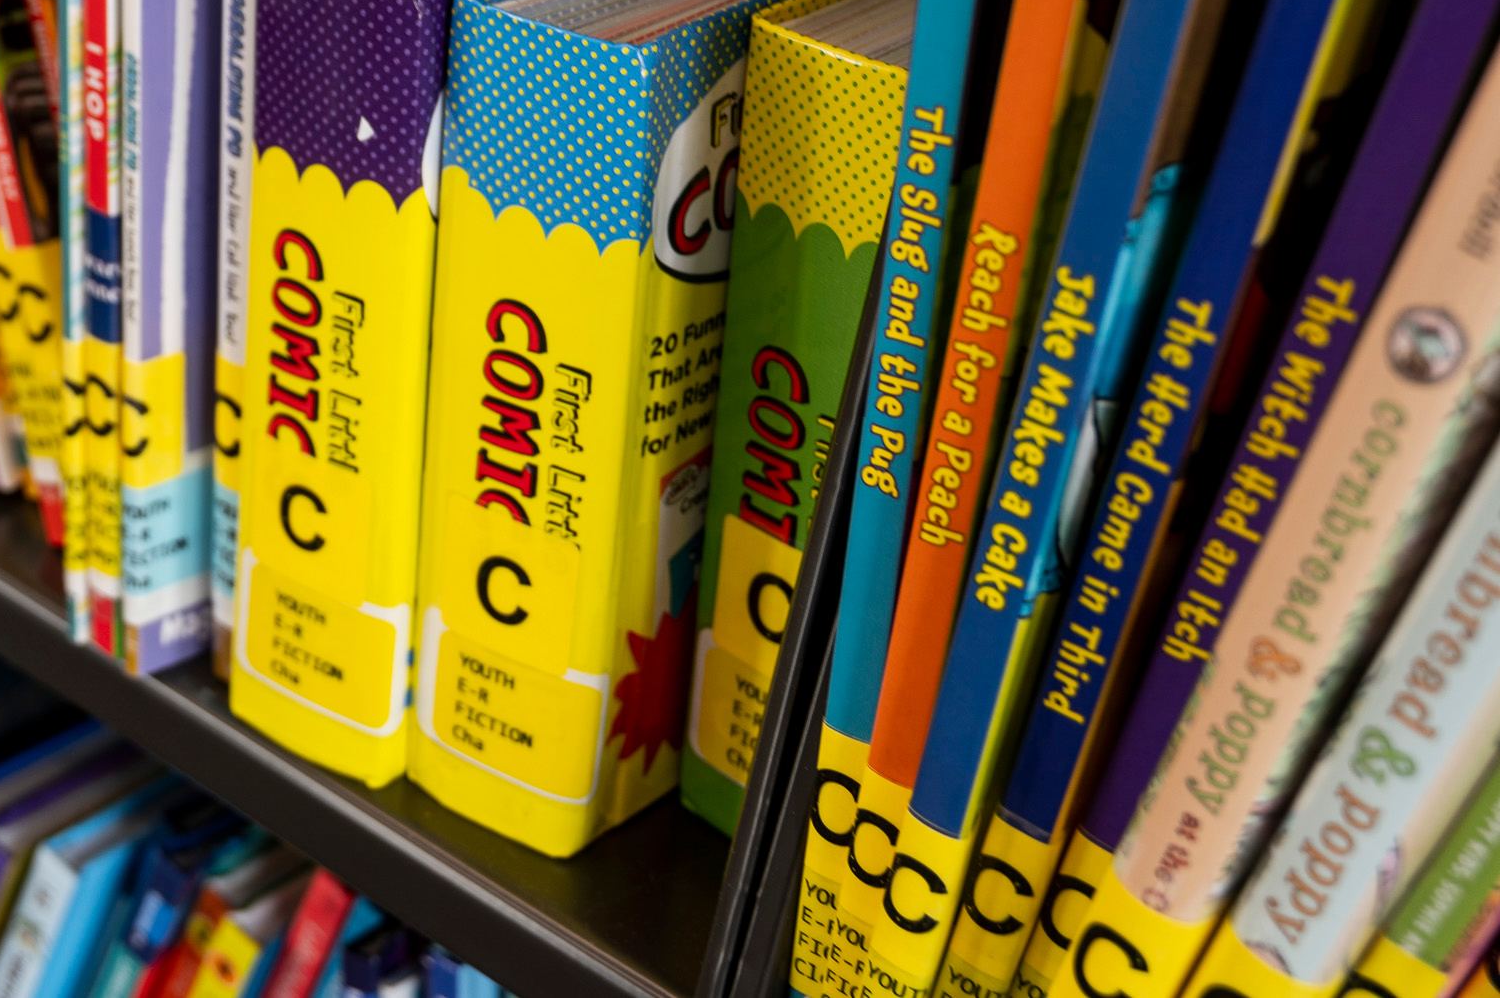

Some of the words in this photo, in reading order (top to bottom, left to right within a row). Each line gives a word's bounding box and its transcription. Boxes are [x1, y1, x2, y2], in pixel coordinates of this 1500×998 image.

[85, 41, 104, 54] I
[86, 66, 105, 142] HOP
[907, 105, 953, 176] The
[891, 183, 942, 273] Slug
[885, 276, 925, 348] and
[961, 223, 1019, 333] Reach
[1042, 266, 1096, 360] Jake
[1293, 275, 1357, 348] The
[266, 227, 325, 459] COMIC
[331, 289, 365, 379] First
[649, 332, 679, 359] 20
[682, 310, 727, 348] Funn
[1158, 298, 1217, 369] The
[551, 362, 592, 455] First
[644, 398, 679, 425] the
[681, 373, 721, 411] Righ
[648, 358, 692, 392] That
[876, 353, 920, 418] the
[952, 340, 997, 404] for
[1246, 352, 1325, 460] Witch
[327, 388, 363, 475] Littl
[640, 433, 672, 458] for
[739, 344, 810, 548] COMI
[861, 423, 905, 499] Pug
[942, 410, 973, 436] a
[1009, 364, 1073, 487] Makes
[1124, 373, 1190, 476] Herd
[279, 483, 328, 552] C
[544, 463, 587, 552] Litt
[919, 441, 973, 546] Peach
[999, 491, 1032, 518] a
[1092, 472, 1154, 572] Came
[1215, 464, 1277, 543] Had
[1274, 398, 1408, 644] cornbread
[476, 555, 532, 625] C
[974, 522, 1028, 611] Cake
[1078, 575, 1120, 615] in
[1196, 539, 1238, 587] an
[1162, 590, 1224, 663] Itch
[456, 676, 489, 705] E-R
[458, 651, 516, 691] YOUTH
[1042, 622, 1106, 725] Third
[451, 723, 485, 752] Cha
[454, 699, 534, 749] FICTION
[1185, 680, 1276, 817] poppy
[810, 768, 861, 847] C
[1175, 811, 1201, 843] at
[847, 808, 900, 889] C
[1263, 781, 1381, 946] poppy
[883, 852, 949, 934] C
[964, 853, 1035, 936] C
